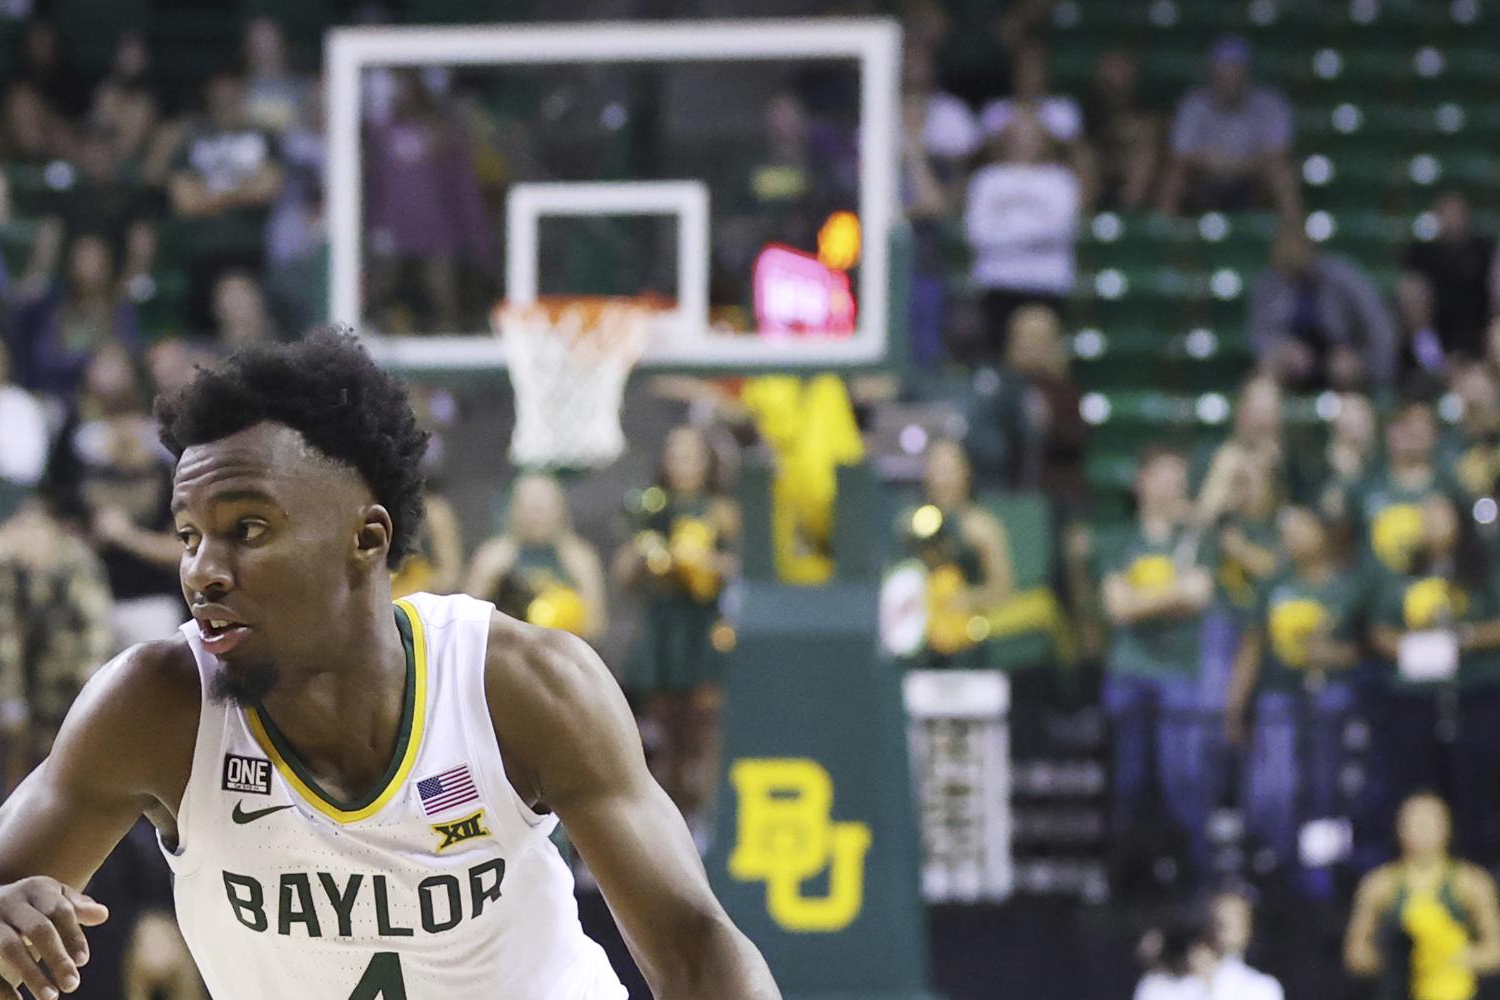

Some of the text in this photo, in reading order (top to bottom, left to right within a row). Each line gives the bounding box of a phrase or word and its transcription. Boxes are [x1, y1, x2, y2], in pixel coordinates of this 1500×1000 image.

[227, 757, 269, 786] ONE
[729, 757, 872, 933] BU
[221, 857, 506, 938] BAYLOR
